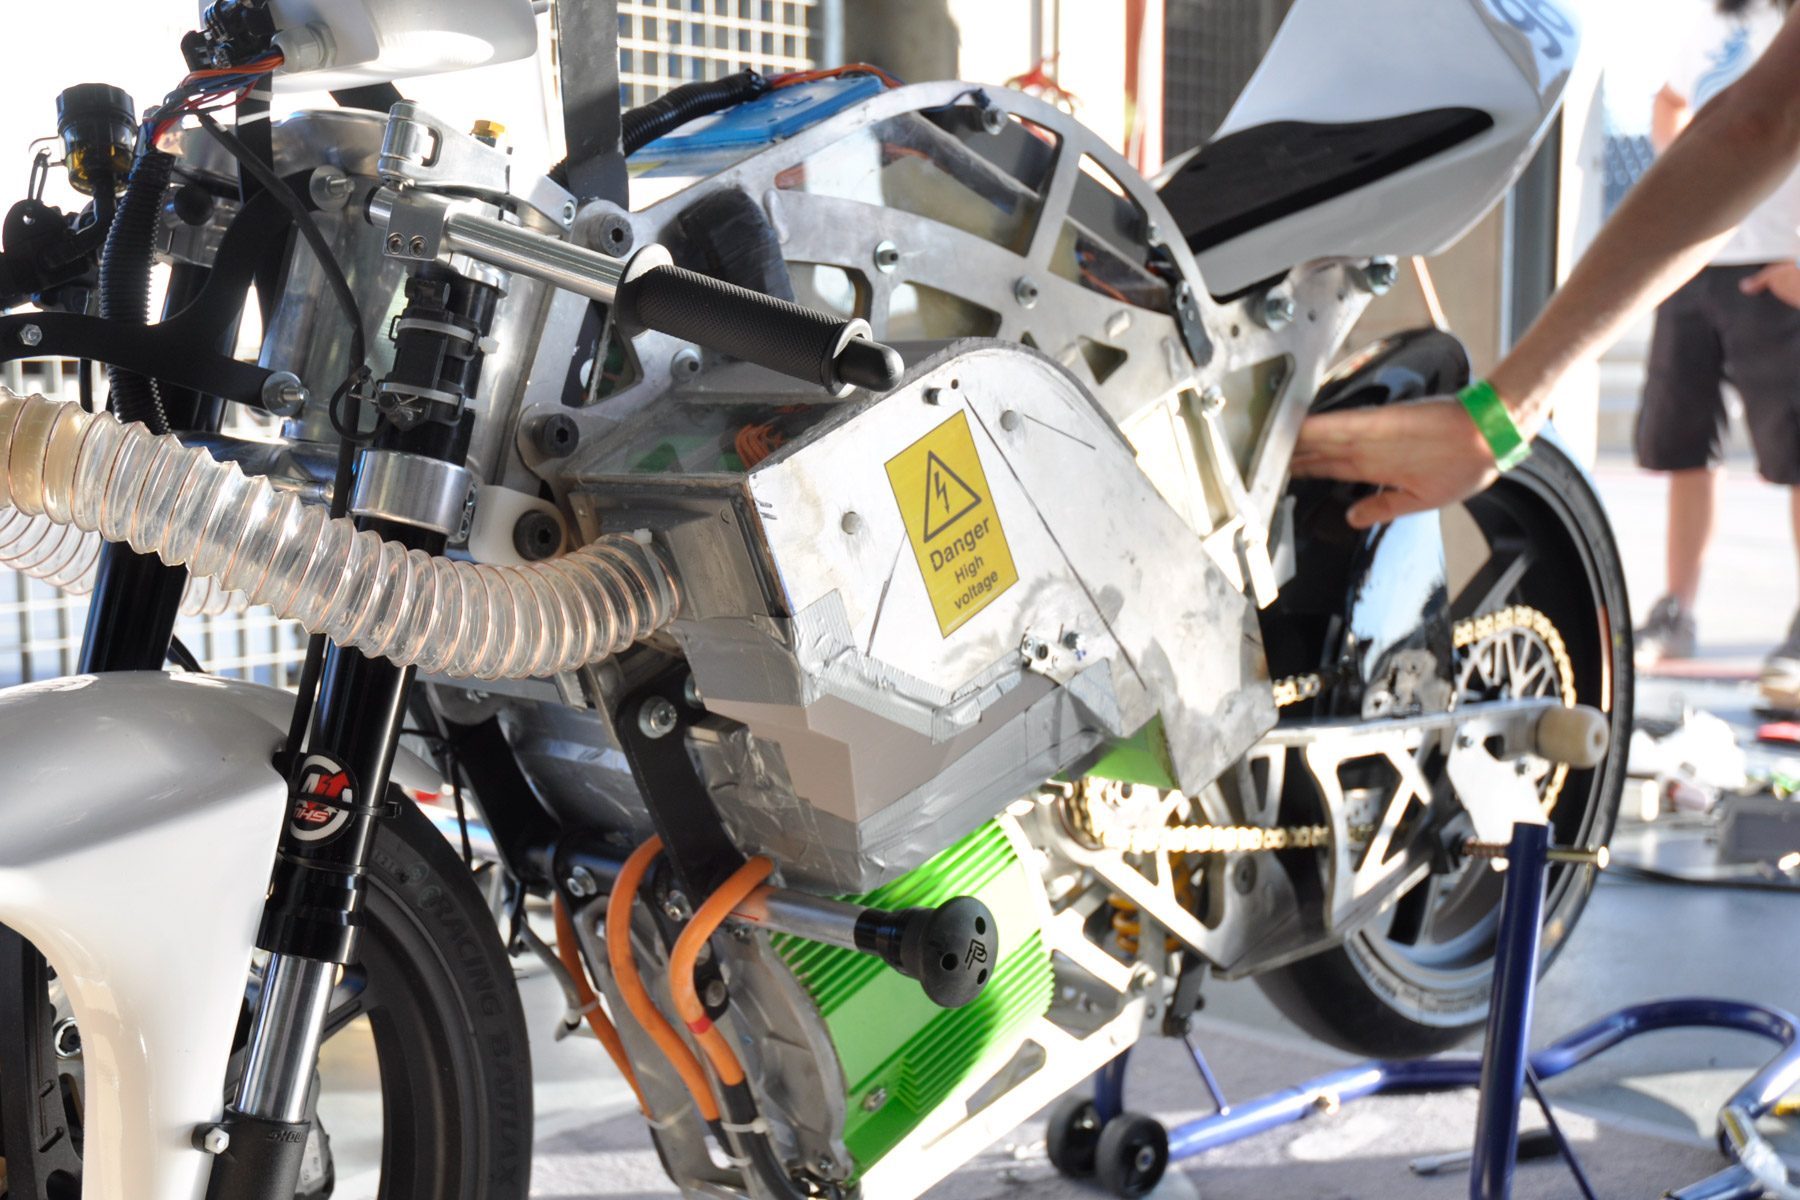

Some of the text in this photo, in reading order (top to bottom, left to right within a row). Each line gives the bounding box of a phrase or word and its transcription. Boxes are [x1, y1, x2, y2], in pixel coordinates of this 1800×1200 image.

[930, 517, 989, 572] Danger
[954, 555, 984, 584] High
[954, 571, 999, 609] voltage
